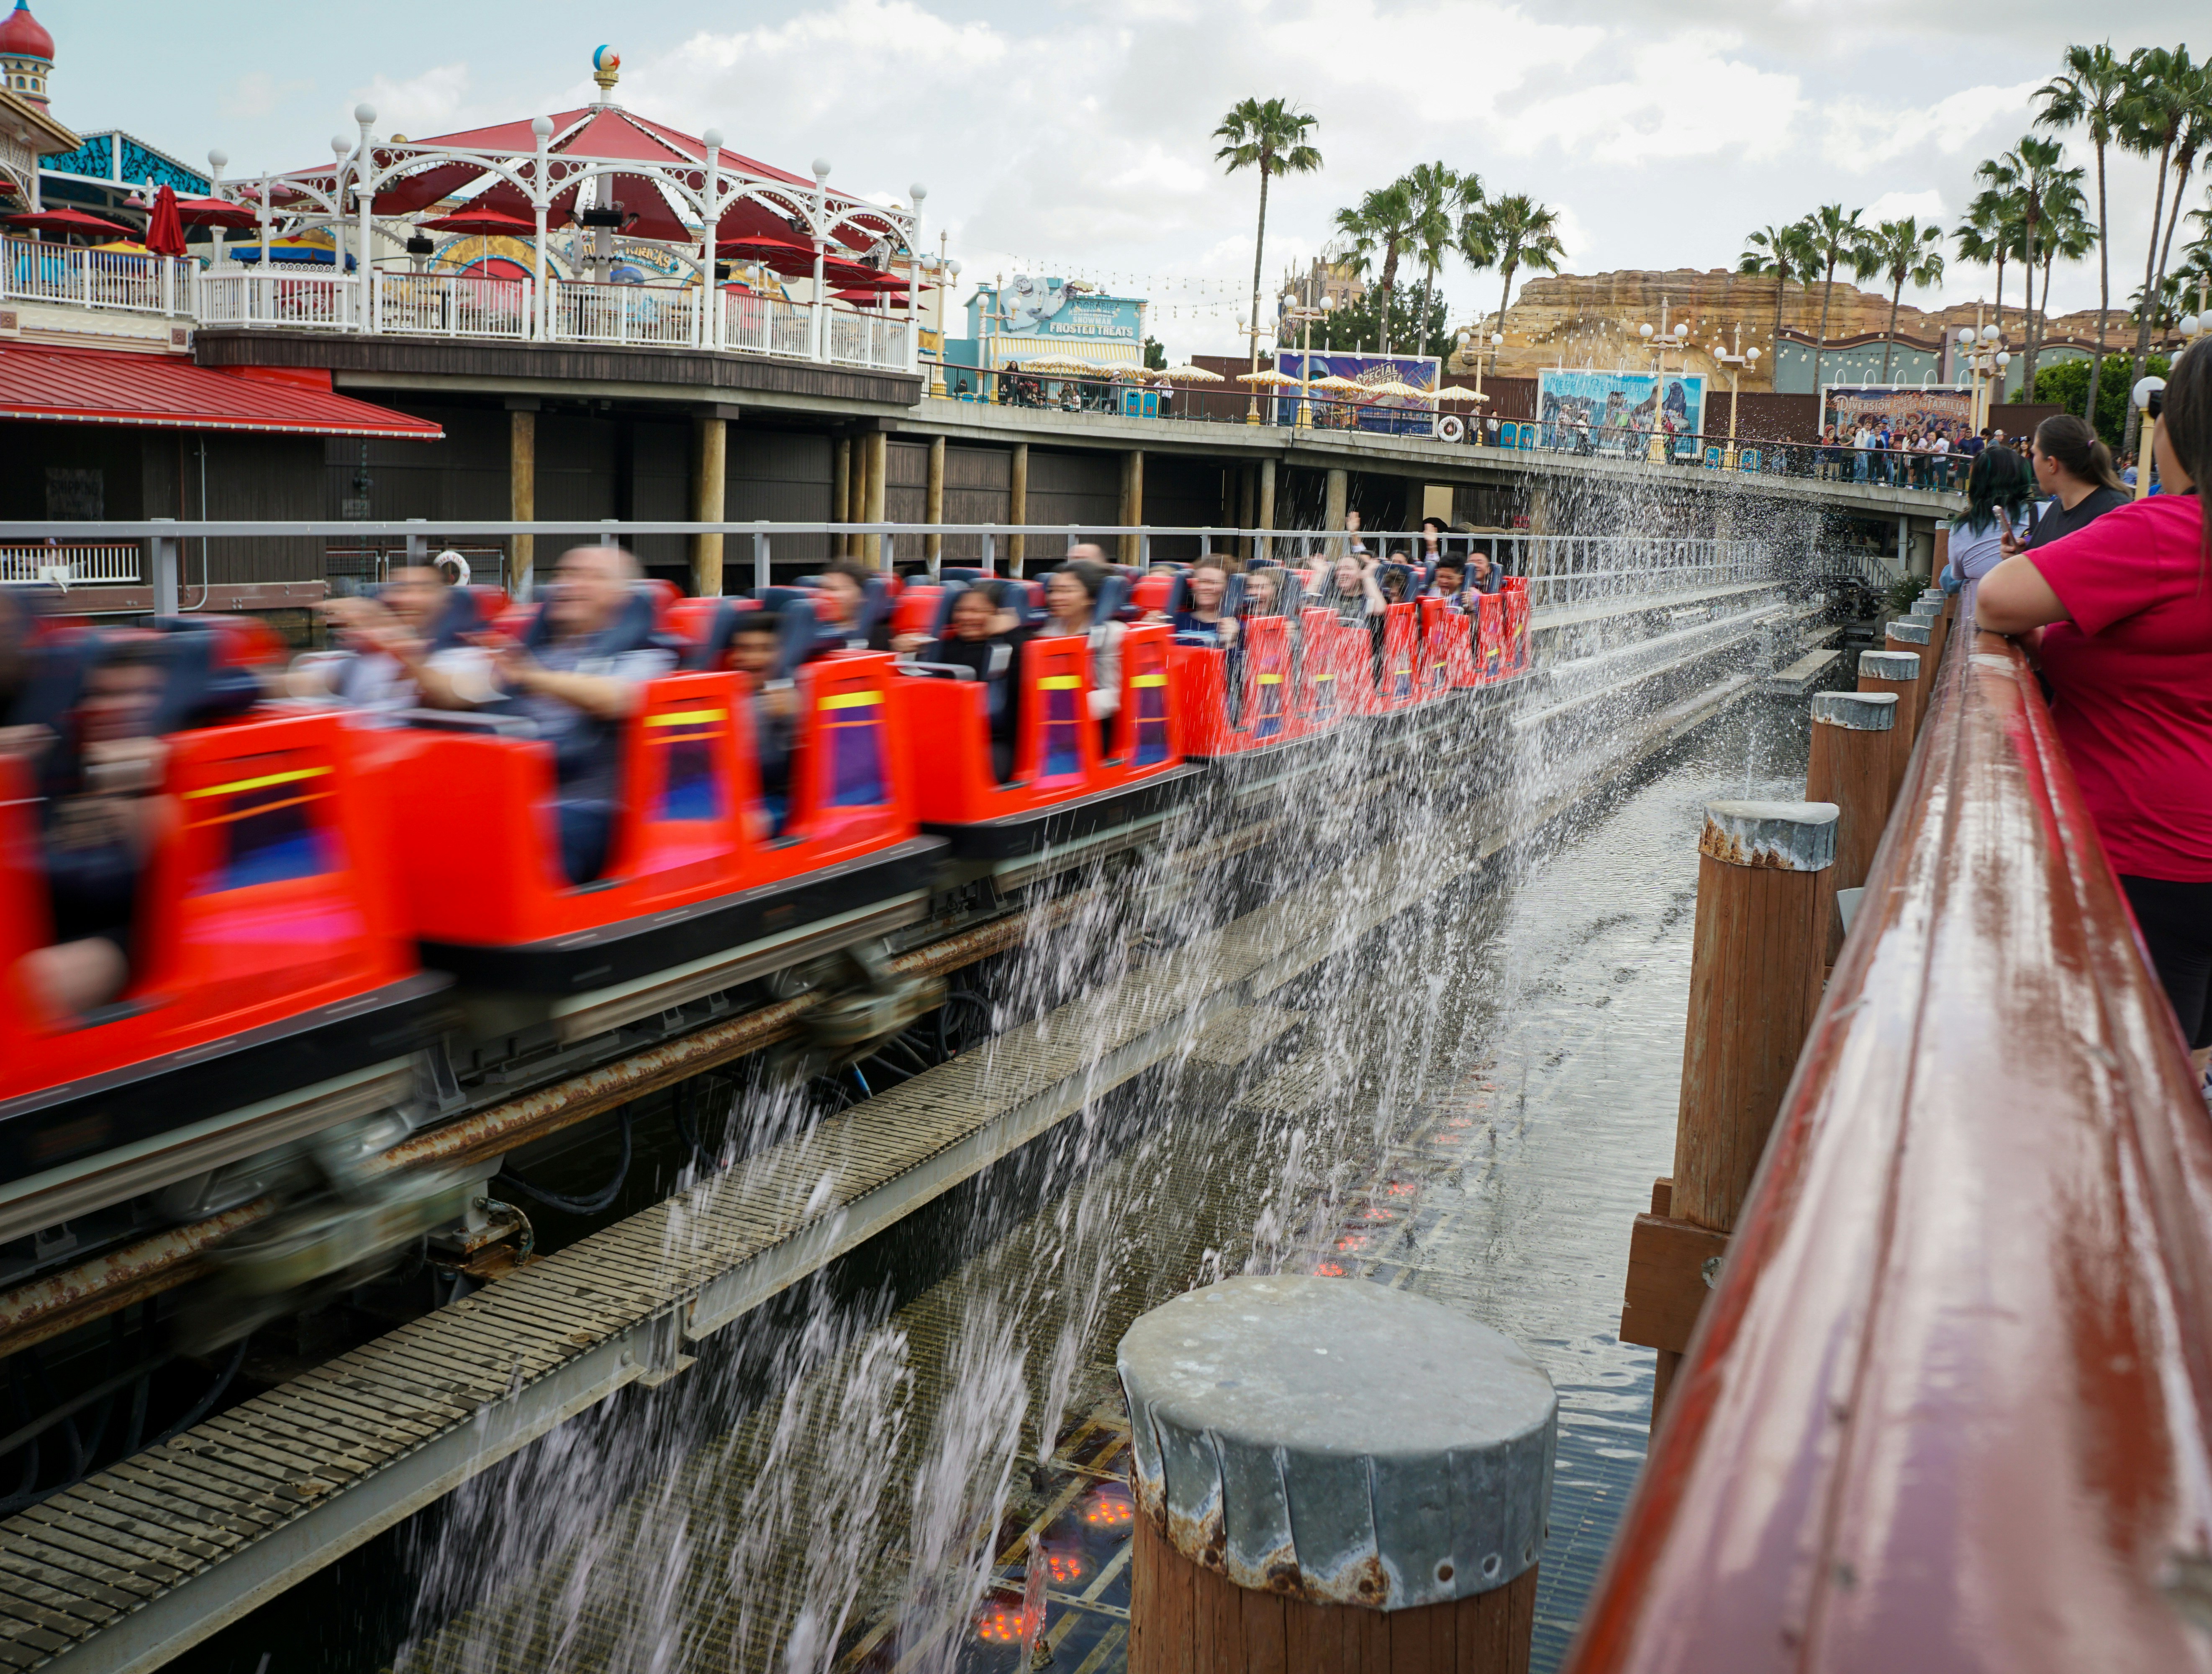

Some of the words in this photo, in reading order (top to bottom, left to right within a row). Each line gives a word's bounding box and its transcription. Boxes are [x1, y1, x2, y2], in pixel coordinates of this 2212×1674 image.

[1073, 316, 1111, 325] SNOWMAN
[1050, 322, 1095, 335] FROSTED
[1097, 325, 1133, 337] TREATS
[1356, 364, 1398, 385] SPECIAL
[1363, 365, 1378, 375] SPARK
[1550, 377, 1577, 393] KEEP
[1590, 378, 1646, 393] BEAUTIFUL
[1894, 394, 1912, 407] para
[1898, 401, 1917, 413] toda
[1924, 394, 1969, 416] FAMILIA!
